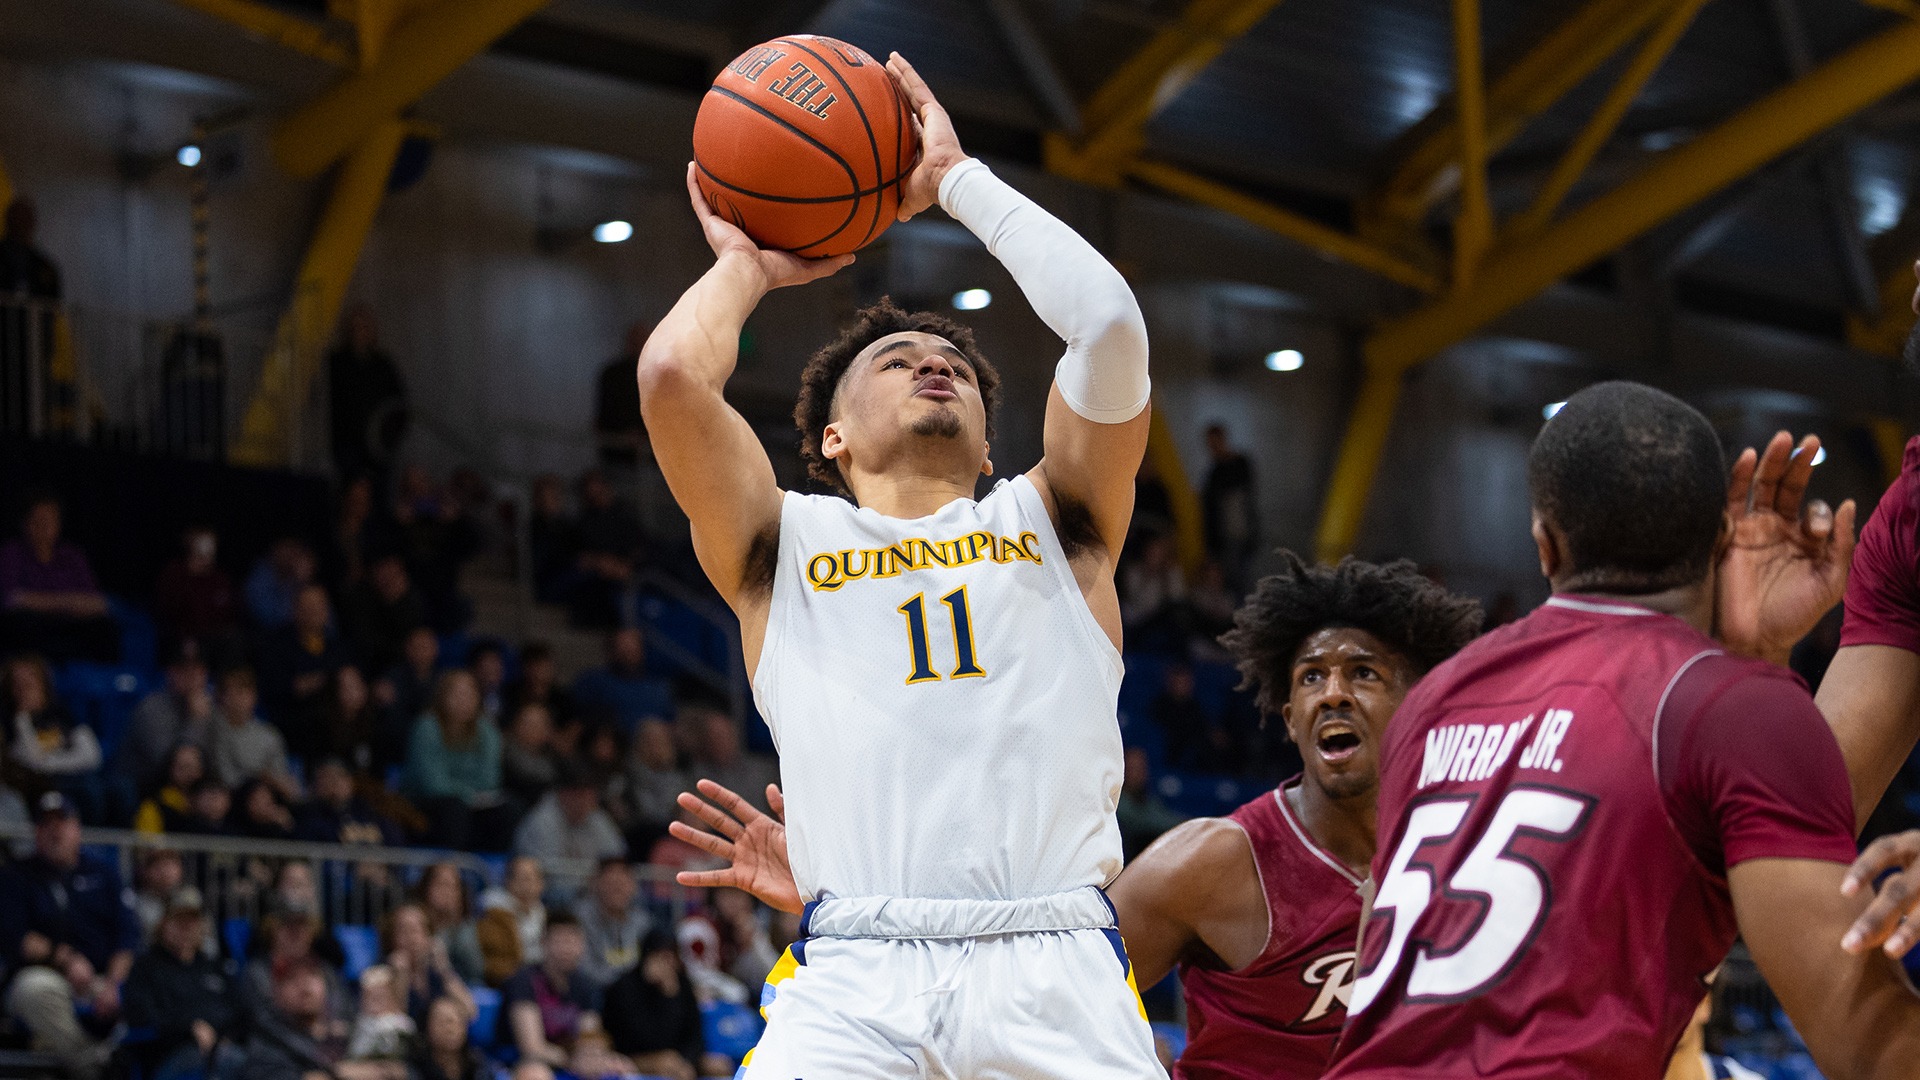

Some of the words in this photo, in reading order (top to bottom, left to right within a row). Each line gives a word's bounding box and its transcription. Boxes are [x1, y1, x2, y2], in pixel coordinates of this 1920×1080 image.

[767, 60, 839, 121] THE
[806, 531, 1043, 592] QUINNIPIAC
[898, 584, 987, 685] 11
[1518, 707, 1574, 773] JR.
[1346, 784, 1597, 1018] 55
[1302, 950, 1357, 1022] R
